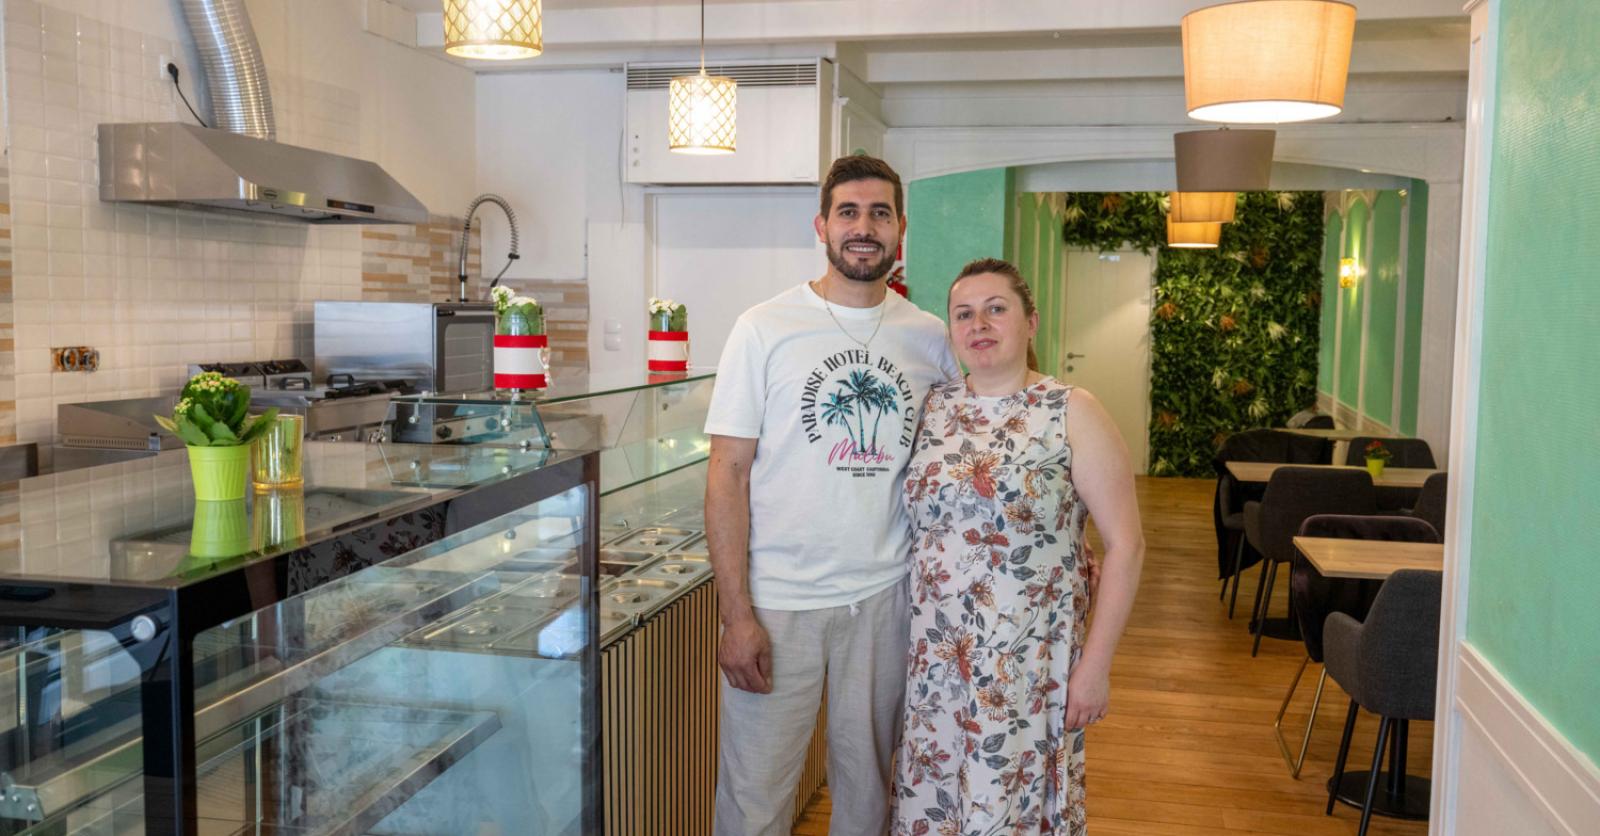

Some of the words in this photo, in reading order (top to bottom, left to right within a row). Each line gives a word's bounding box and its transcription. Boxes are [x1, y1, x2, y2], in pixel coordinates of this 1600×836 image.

[801, 367, 828, 444] PARADISE
[823, 349, 873, 372] HOTEL
[877, 356, 912, 401] BEACH
[899, 407, 915, 448] CLUB
[828, 437, 895, 465] Malibu
